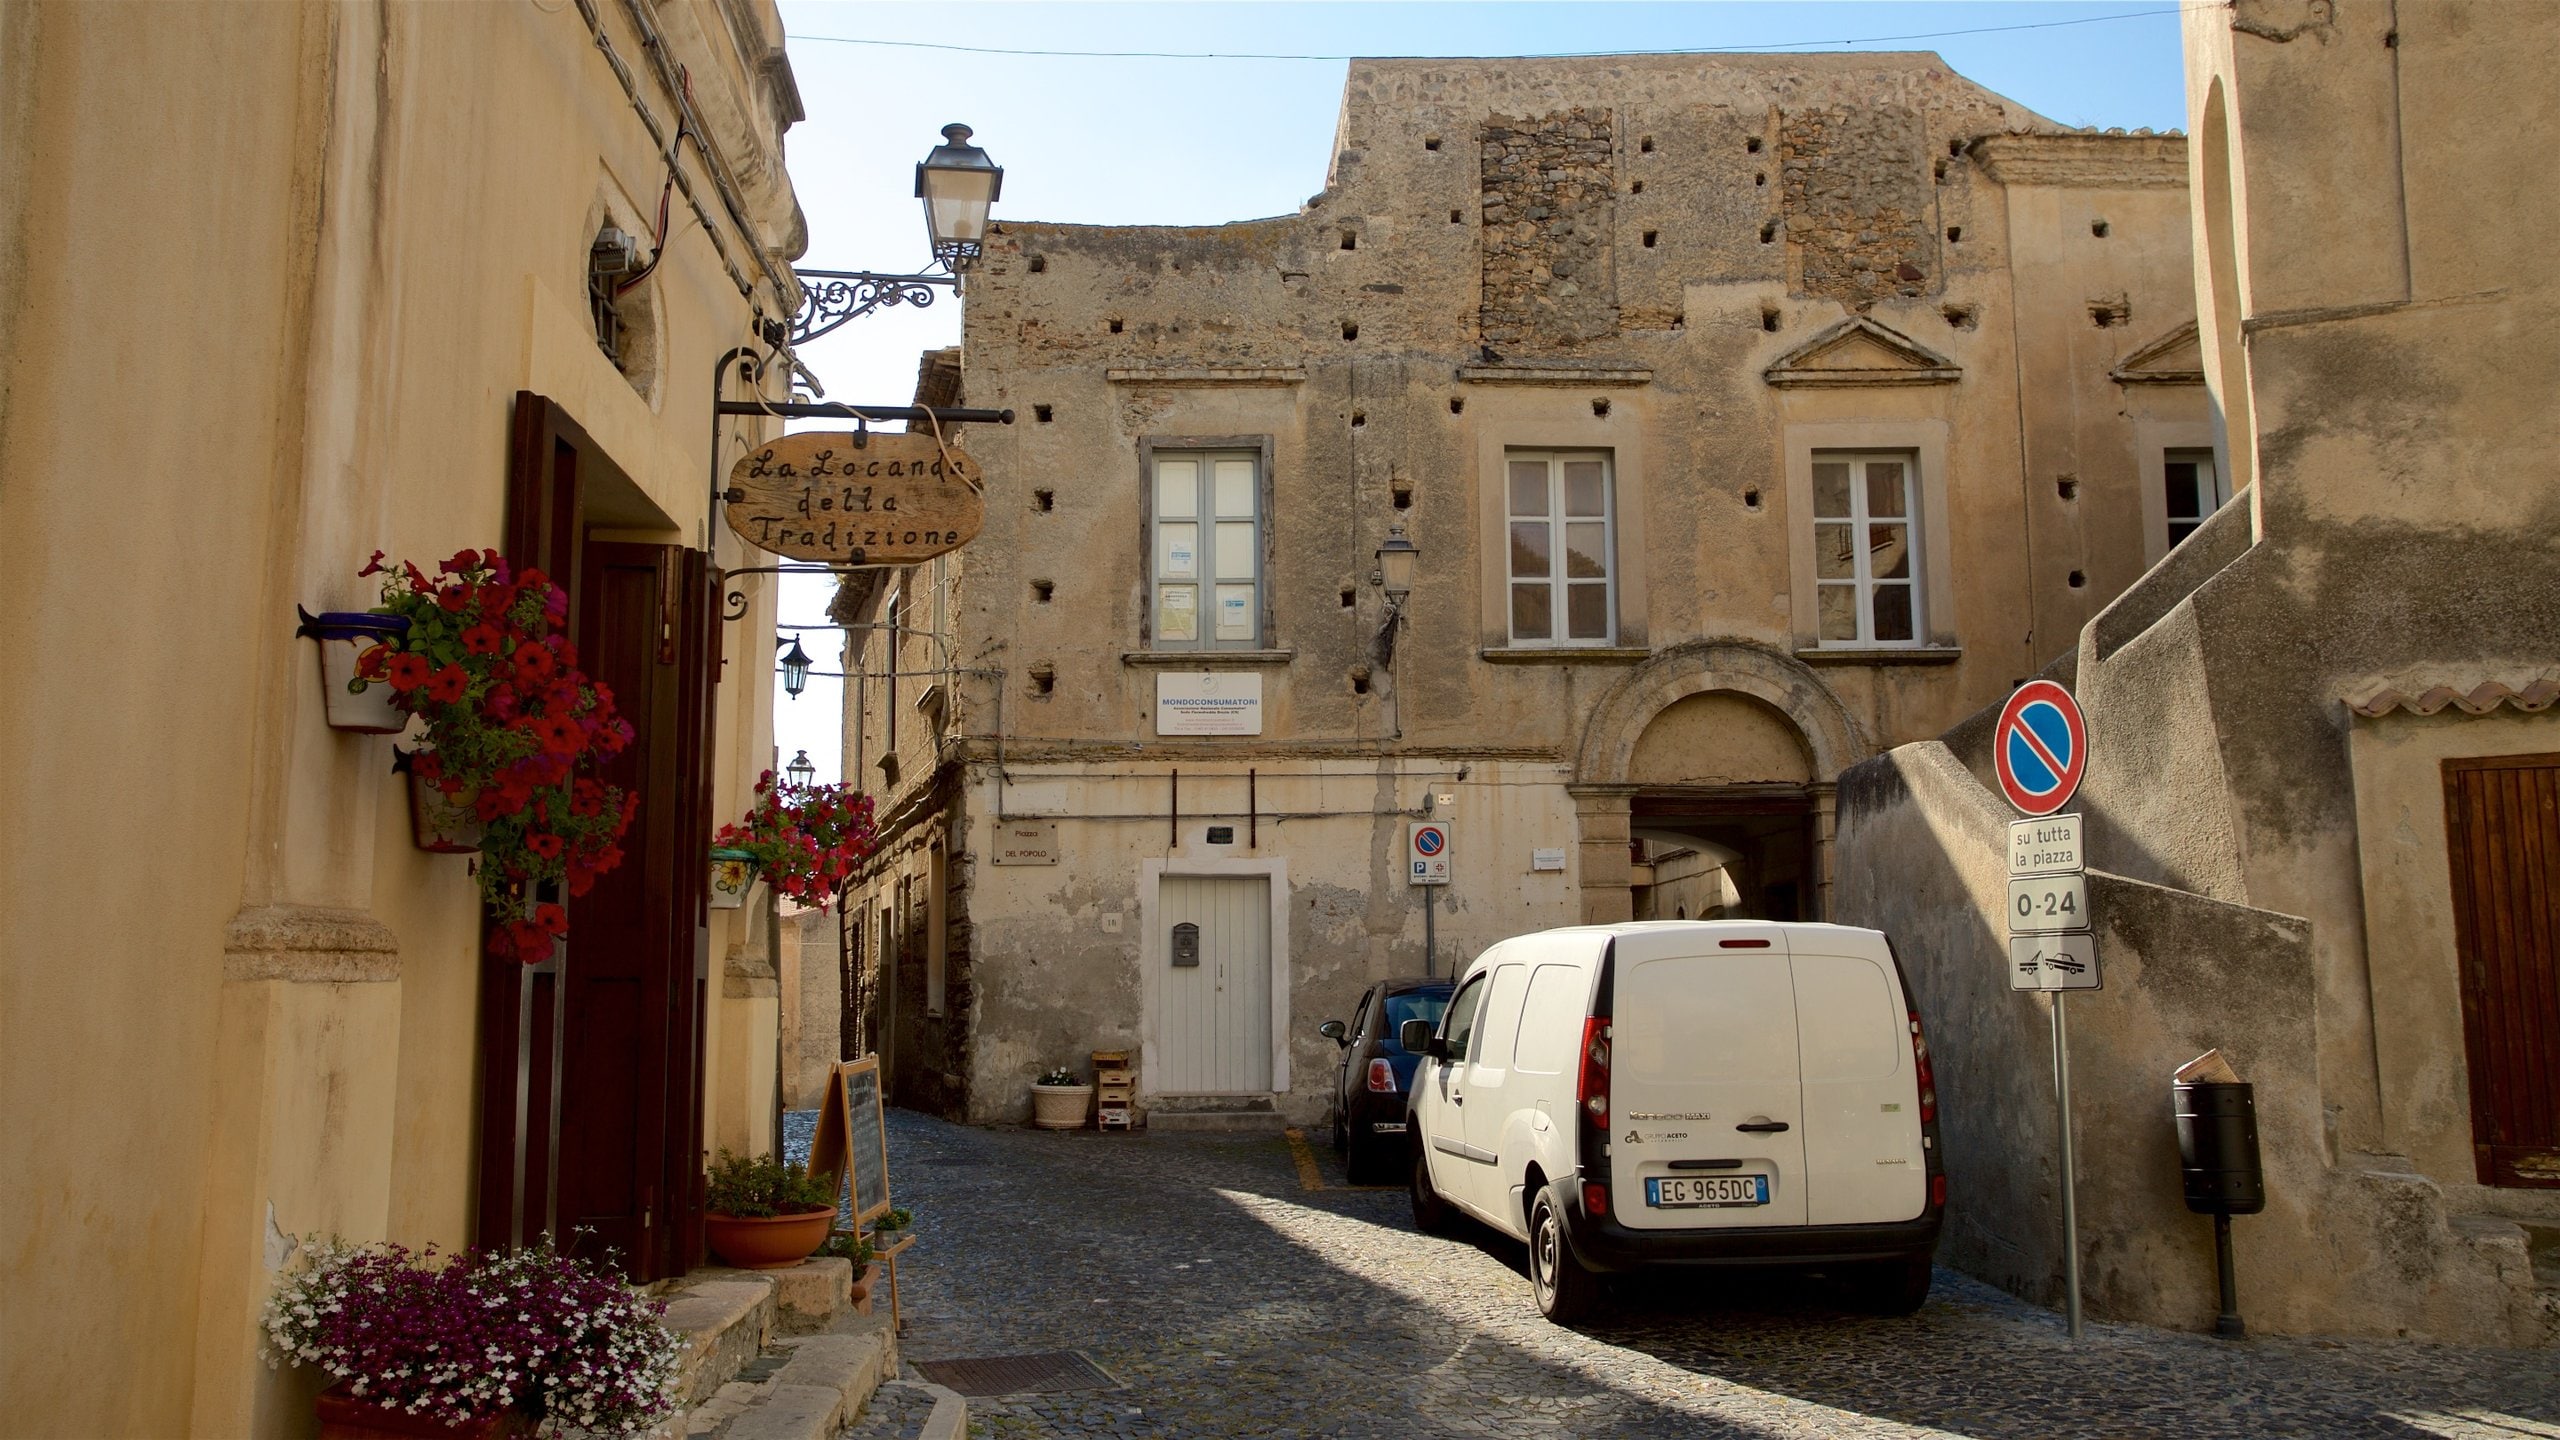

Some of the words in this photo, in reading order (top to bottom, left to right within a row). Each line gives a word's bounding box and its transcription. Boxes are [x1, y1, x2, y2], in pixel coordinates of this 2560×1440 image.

[750, 449, 796, 479] La
[811, 449, 964, 482] Locanda
[798, 486, 897, 520] della
[750, 516, 958, 551] Tradizione
[1162, 698, 1258, 706] MONDOCONSUMATORI
[2017, 832, 2030, 846] su
[2037, 826, 2071, 843] tutta
[1416, 863, 1424, 873] P
[2015, 852, 2027, 867] la
[2033, 849, 2073, 868] piazza
[2017, 891, 2076, 916] 0-24
[1685, 1112, 1711, 1120] MAXI
[1661, 1181, 1685, 1202] EG
[1693, 1180, 1754, 1200] 965DC
